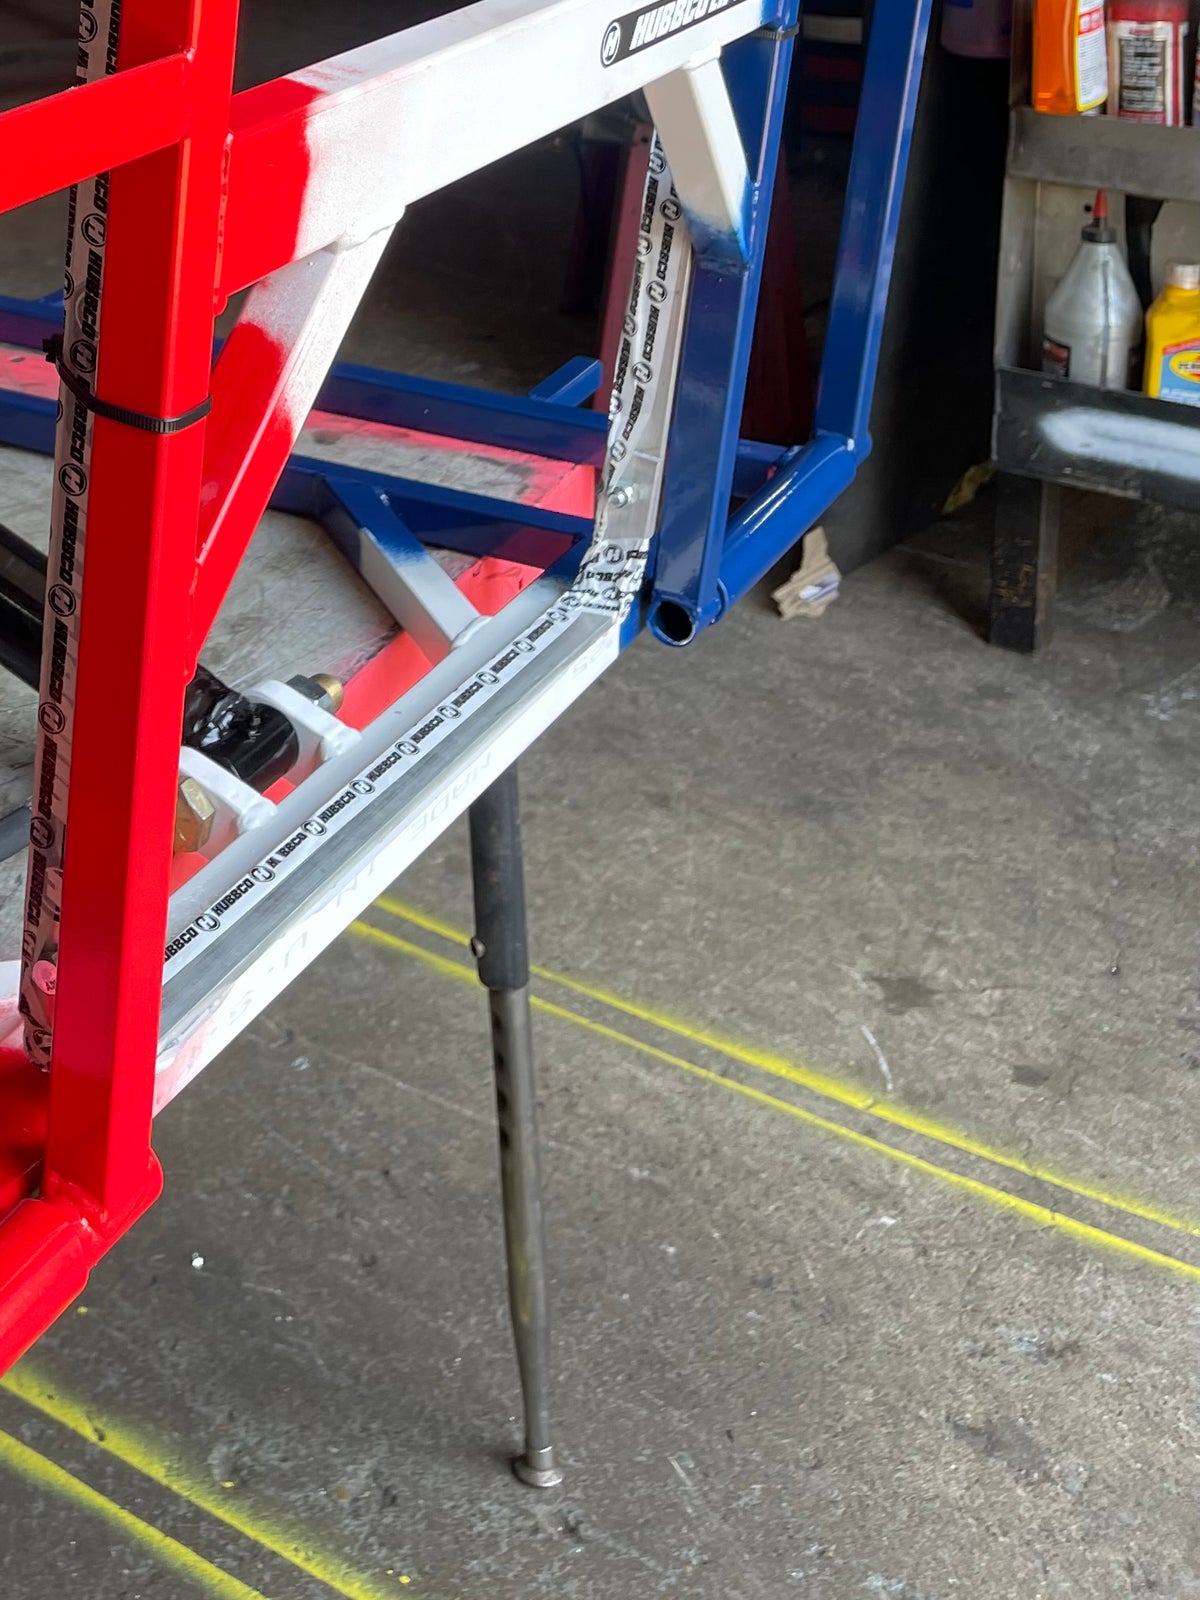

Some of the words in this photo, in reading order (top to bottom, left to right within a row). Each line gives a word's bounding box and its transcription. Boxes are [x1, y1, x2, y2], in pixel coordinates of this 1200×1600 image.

[82, 248, 103, 341] HUBBCO
[656, 222, 674, 280] HUBBCO
[642, 304, 660, 361] HUBBCO
[60, 497, 79, 586] HUBBCO
[49, 617, 68, 704] HUBBCO
[163, 927, 198, 962] UBBCO
[211, 878, 255, 916] HUBBCO
[318, 792, 356, 823] HUBBCO
[366, 752, 402, 782] HUBBCO
